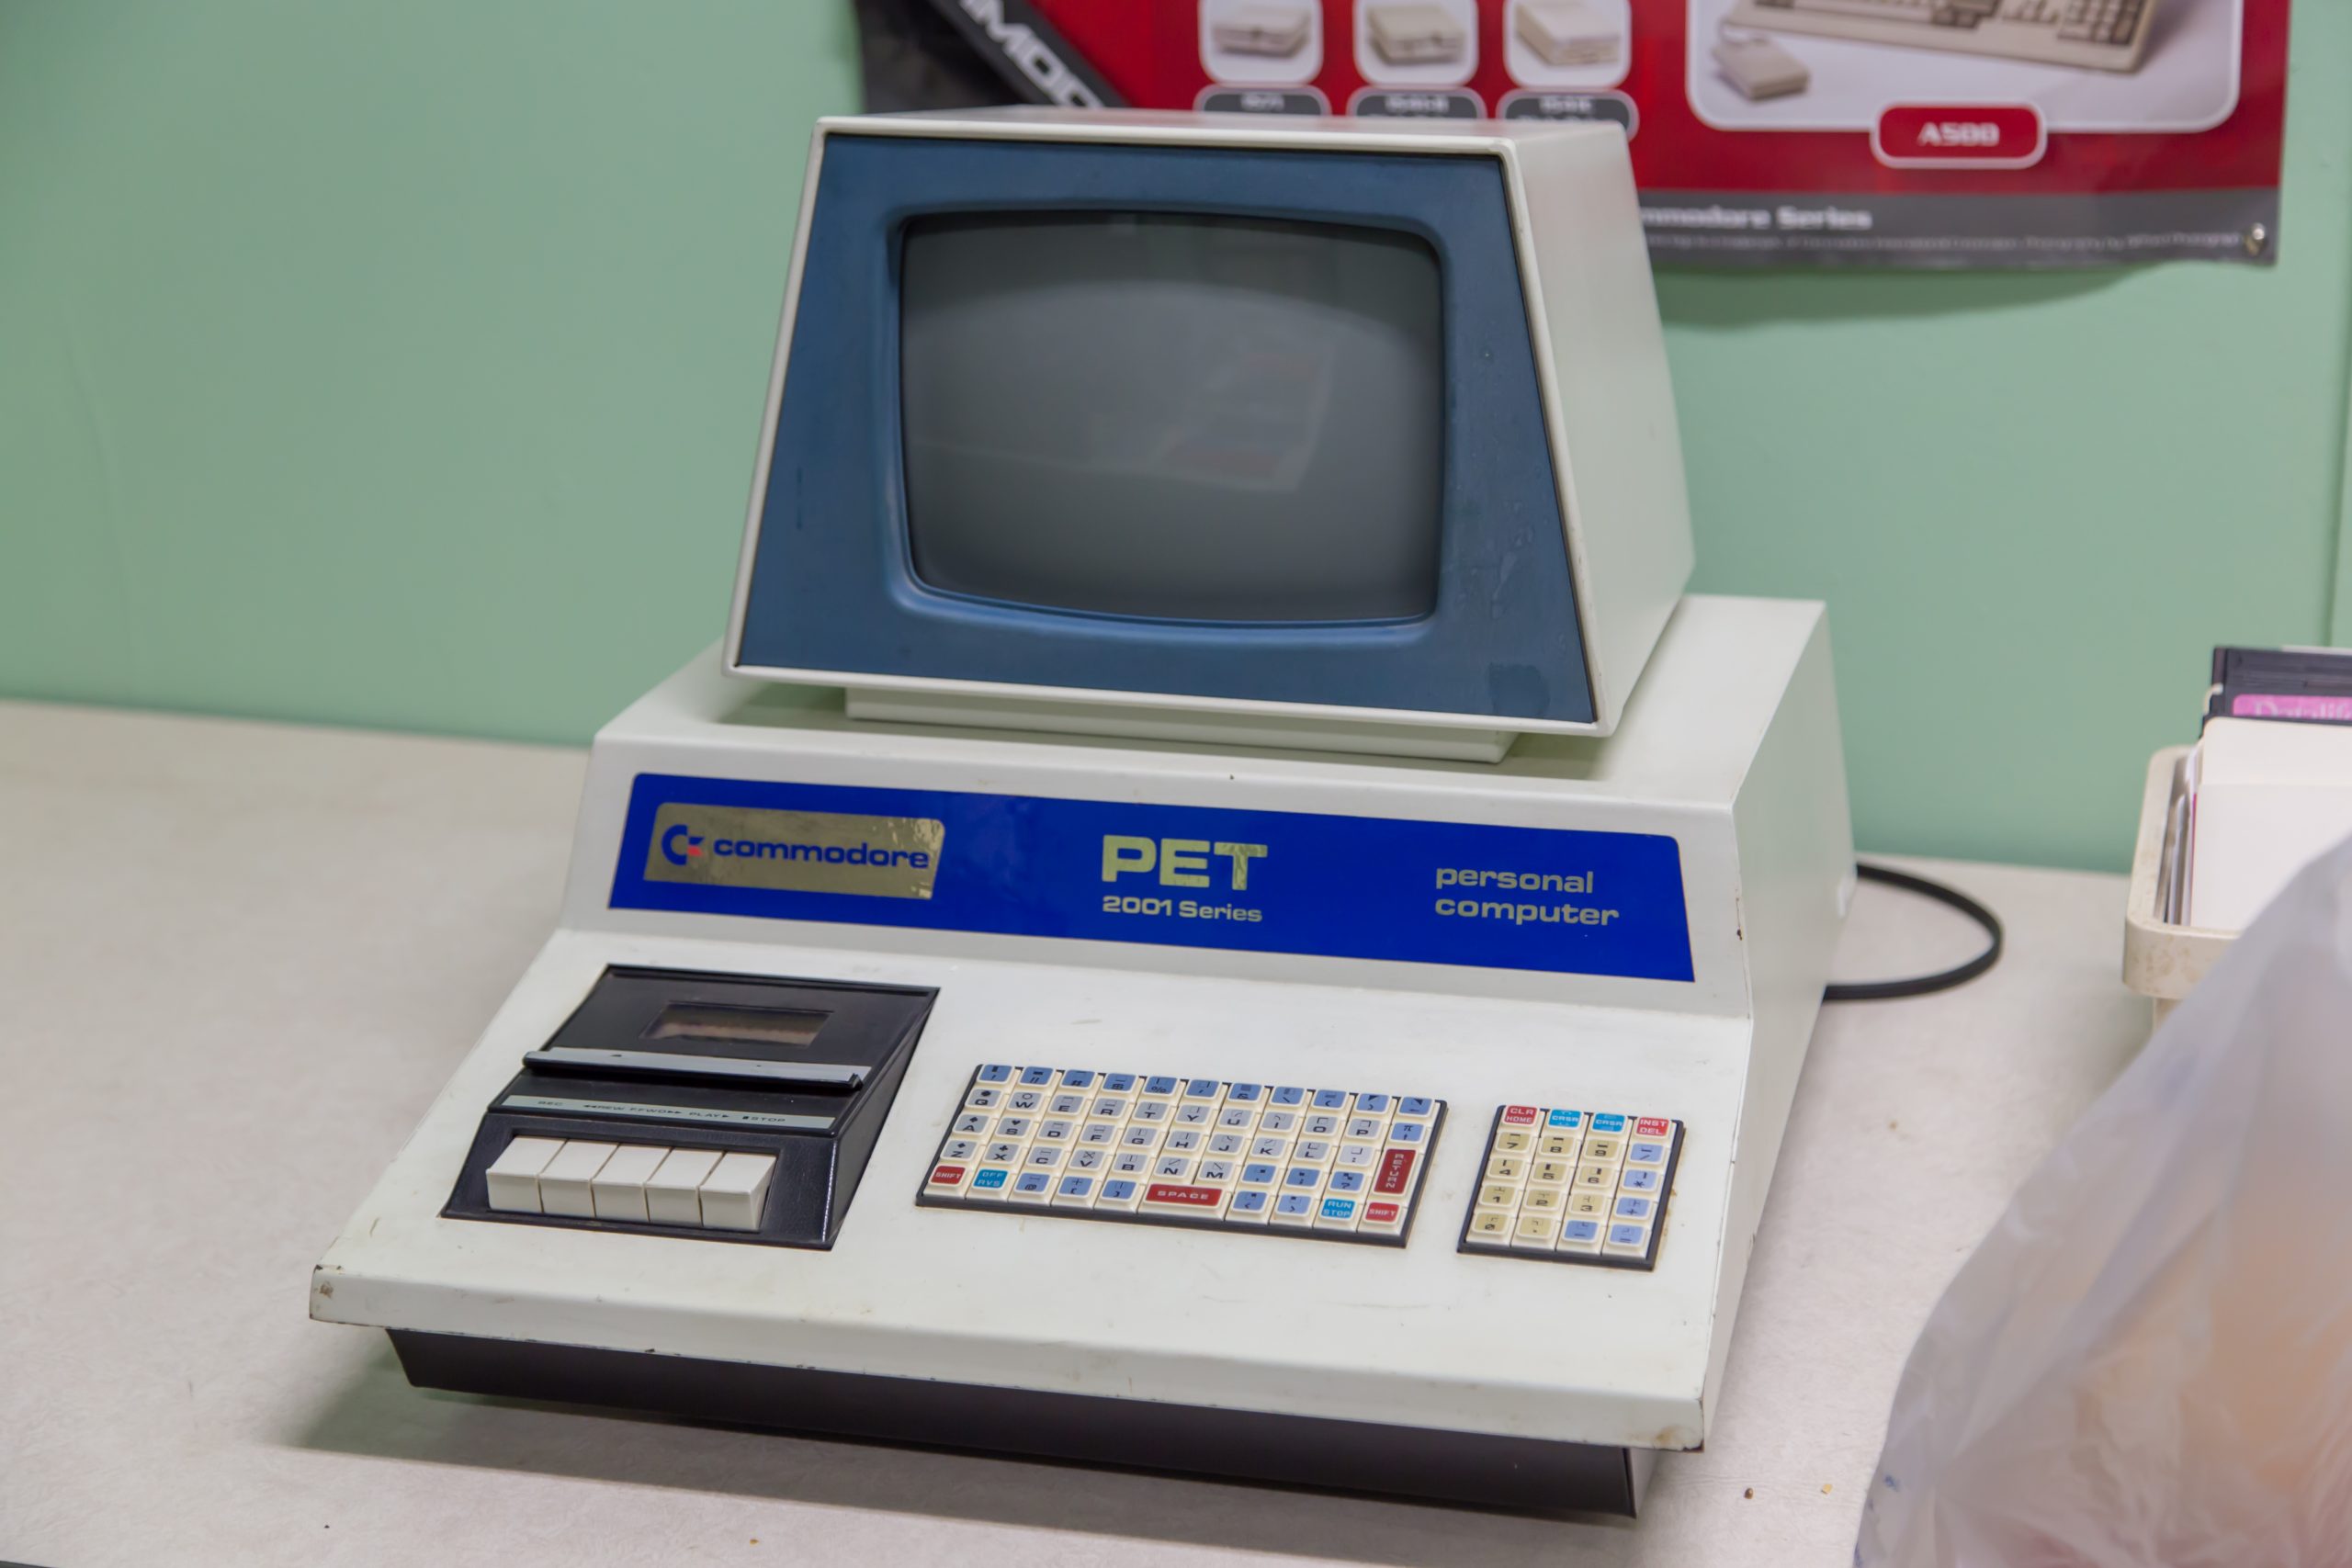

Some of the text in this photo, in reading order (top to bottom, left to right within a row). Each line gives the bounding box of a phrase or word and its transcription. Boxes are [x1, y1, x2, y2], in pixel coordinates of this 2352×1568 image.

[1777, 206, 1872, 230] Series
[713, 838, 929, 869] commodore
[1102, 834, 1268, 890] PET
[1436, 867, 1594, 894] personal
[1102, 896, 1263, 922] 2001 Series
[1435, 898, 1620, 926] computer
[1510, 1107, 1534, 1115] CLR
[1507, 1115, 1532, 1123] HOME
[1639, 1119, 1668, 1127] INST
[1260, 1147, 1272, 1156] K
[935, 1171, 962, 1179] SHIFT
[1385, 1153, 1404, 1189] RETURN
[1157, 1190, 1209, 1200] SPACE
[1327, 1201, 1352, 1209] RUN
[1322, 1209, 1351, 1217] STOP
